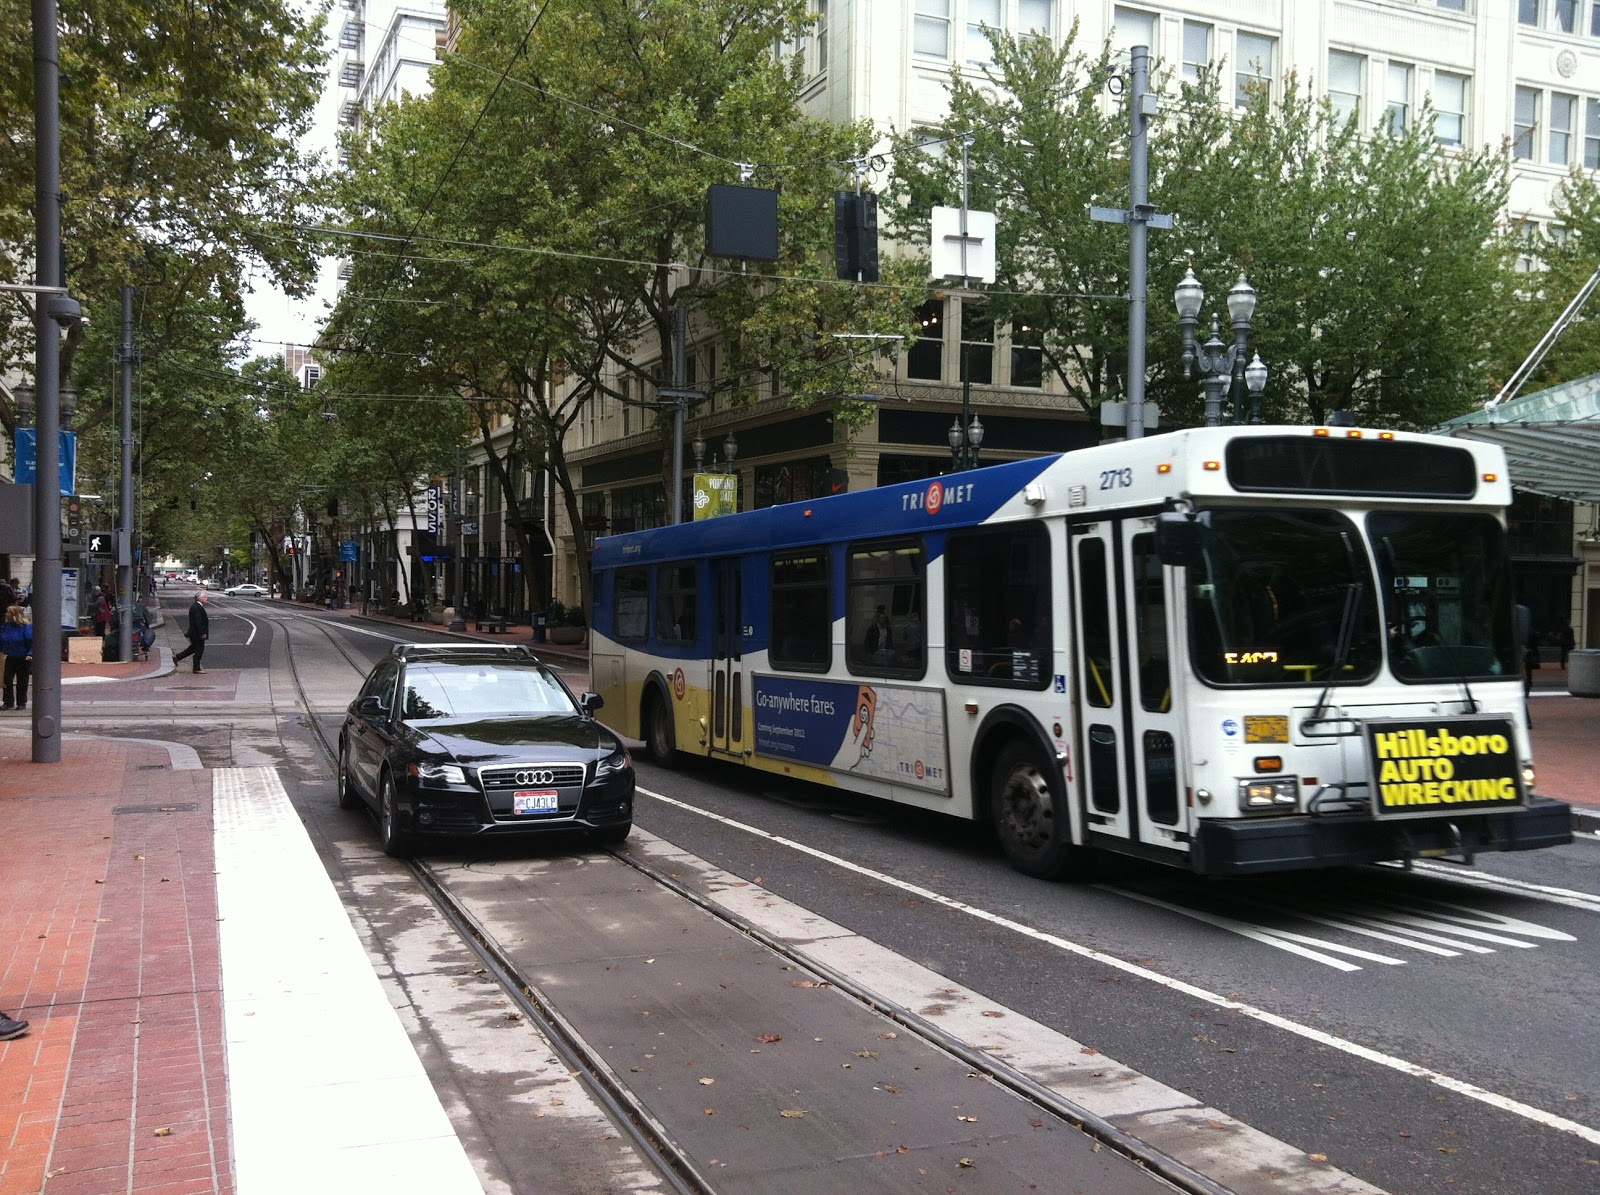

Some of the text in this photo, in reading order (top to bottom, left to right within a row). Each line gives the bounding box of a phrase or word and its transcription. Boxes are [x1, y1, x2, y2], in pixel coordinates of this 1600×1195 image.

[1100, 467, 1132, 490] 2713
[428, 488, 437, 533] ROSS
[902, 484, 974, 511] TRI MET
[756, 690, 835, 715] Go-anywhere fares
[1375, 728, 1509, 759] Hillsboro
[1379, 757, 1455, 783] AUTO
[1380, 777, 1516, 807] WRECKING
